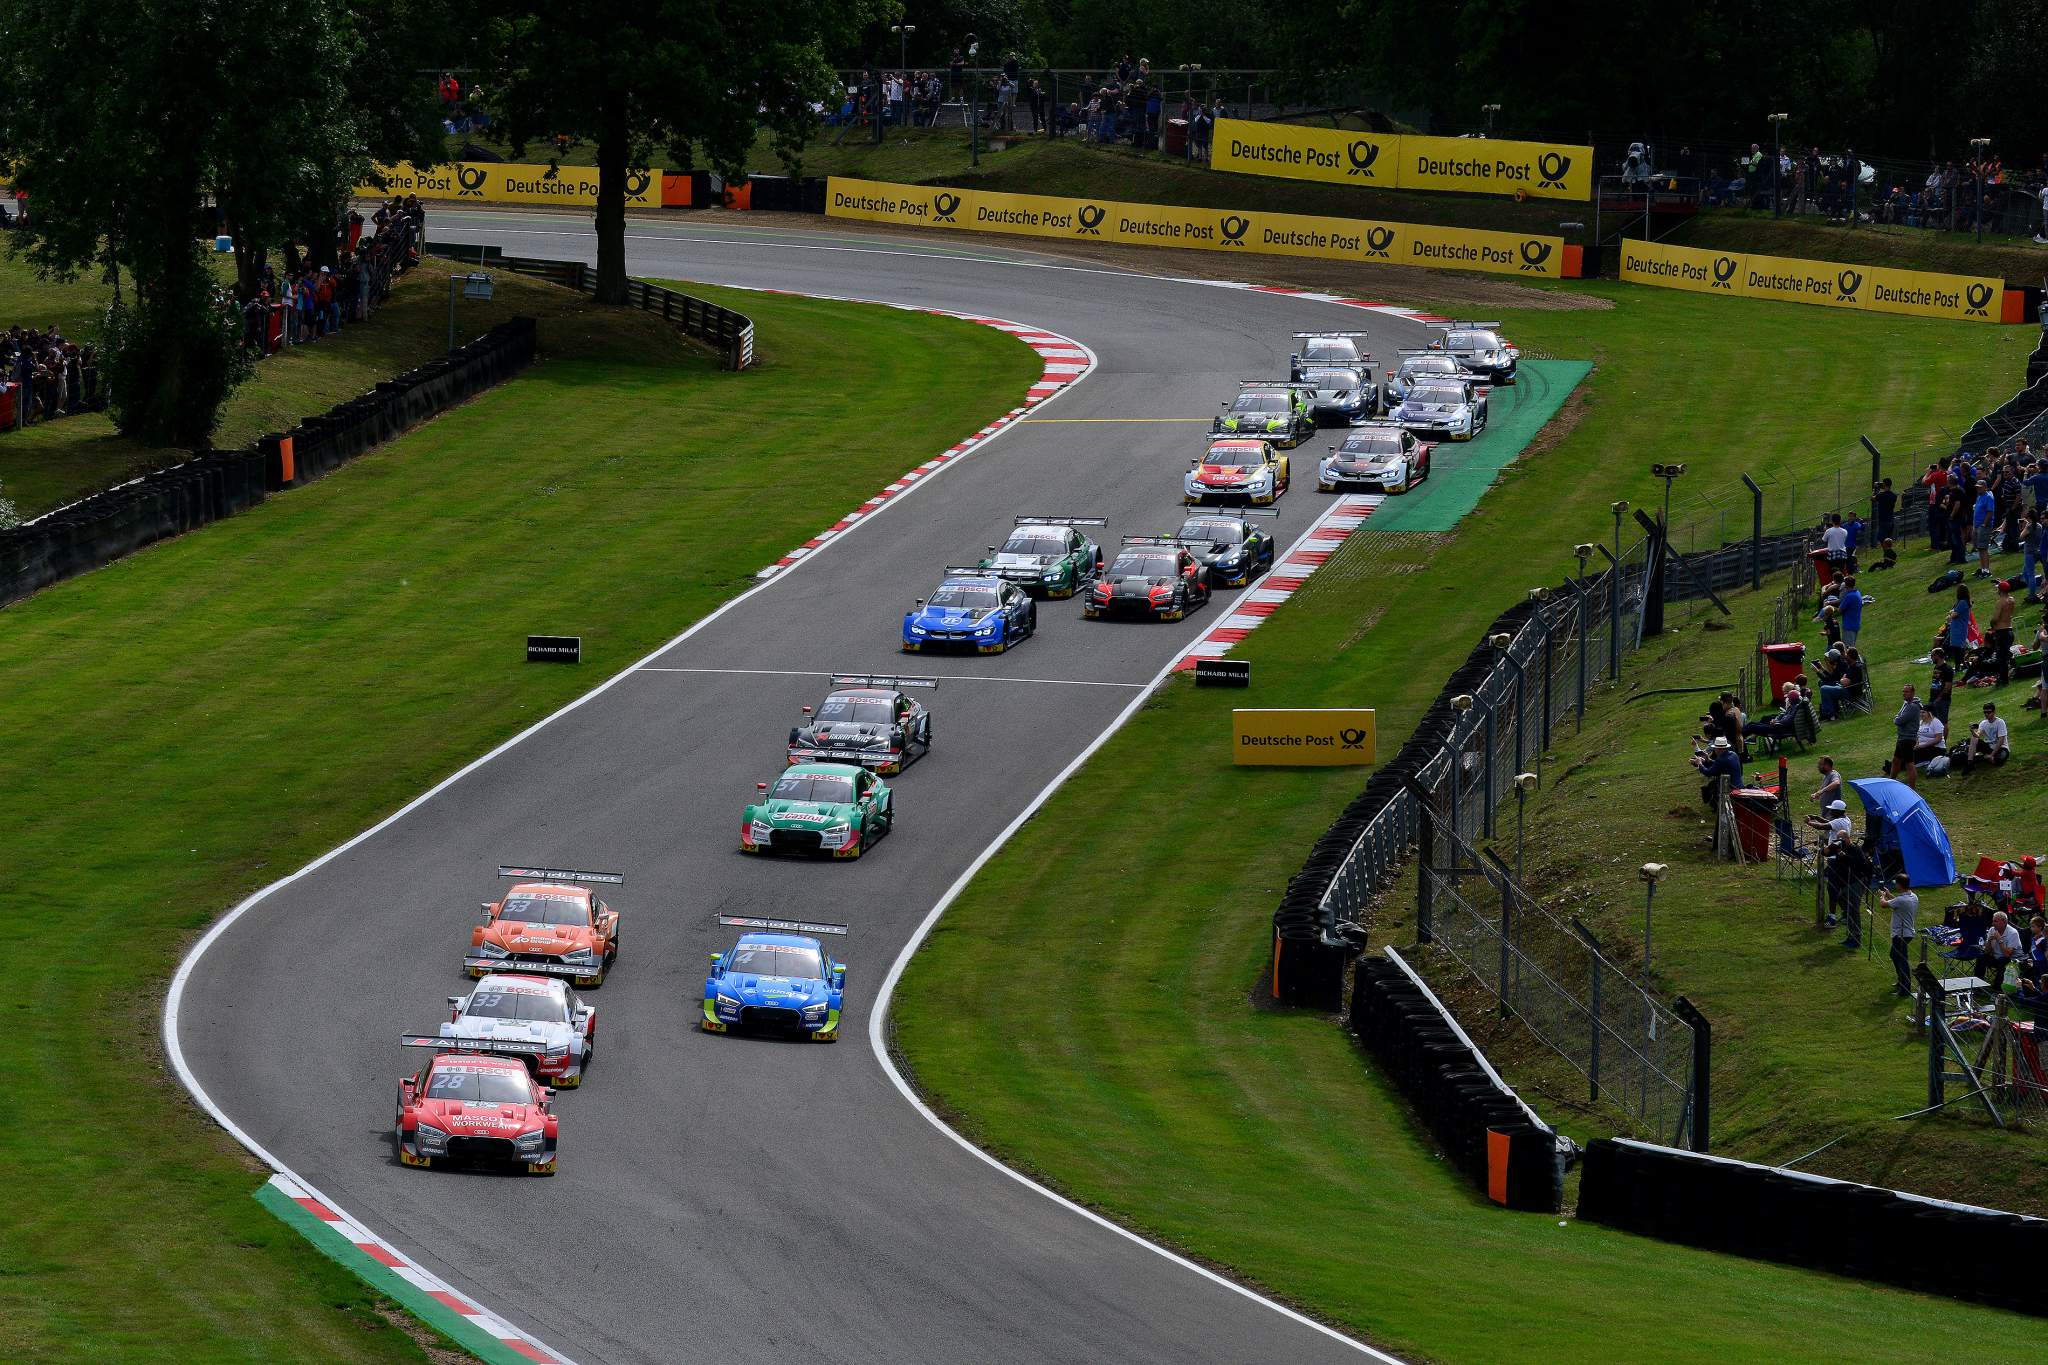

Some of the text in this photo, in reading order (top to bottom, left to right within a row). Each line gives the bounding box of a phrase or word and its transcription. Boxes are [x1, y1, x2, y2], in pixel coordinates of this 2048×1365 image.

[1232, 140, 1340, 168] Deutsche Post
[1418, 157, 1530, 180] Deutsche Post
[417, 175, 450, 190] Post
[506, 178, 600, 196] Deutsche Po
[835, 193, 928, 216] Deutsche Post
[978, 207, 1072, 227] Deutsche Post
[1120, 219, 1213, 239] Deutsche Post
[1264, 229, 1360, 250] Deutsche Post
[1413, 241, 1513, 264] Deutsche Post
[1627, 256, 1707, 280] Deutsche Post
[1749, 272, 1832, 294] Deutsche Post
[1875, 285, 1959, 308] Deutsche Post
[1197, 670, 1227, 678] RICHARD
[822, 704, 846, 714] 99
[1242, 735, 1334, 745] Deutsche Post
[806, 774, 843, 782] BOSCH
[777, 781, 800, 791] 51
[784, 813, 824, 823] Castrol
[529, 870, 619, 882] Audi Sport
[505, 900, 531, 913] 53
[750, 921, 842, 933] Audi Sport
[737, 951, 756, 964] 4
[496, 961, 592, 974] Audi Sport
[506, 986, 551, 996] BOSCH
[472, 995, 503, 1007] 33
[436, 1039, 540, 1052] Audi Sport
[466, 1067, 513, 1076] BOSCH
[432, 1075, 465, 1089] 28
